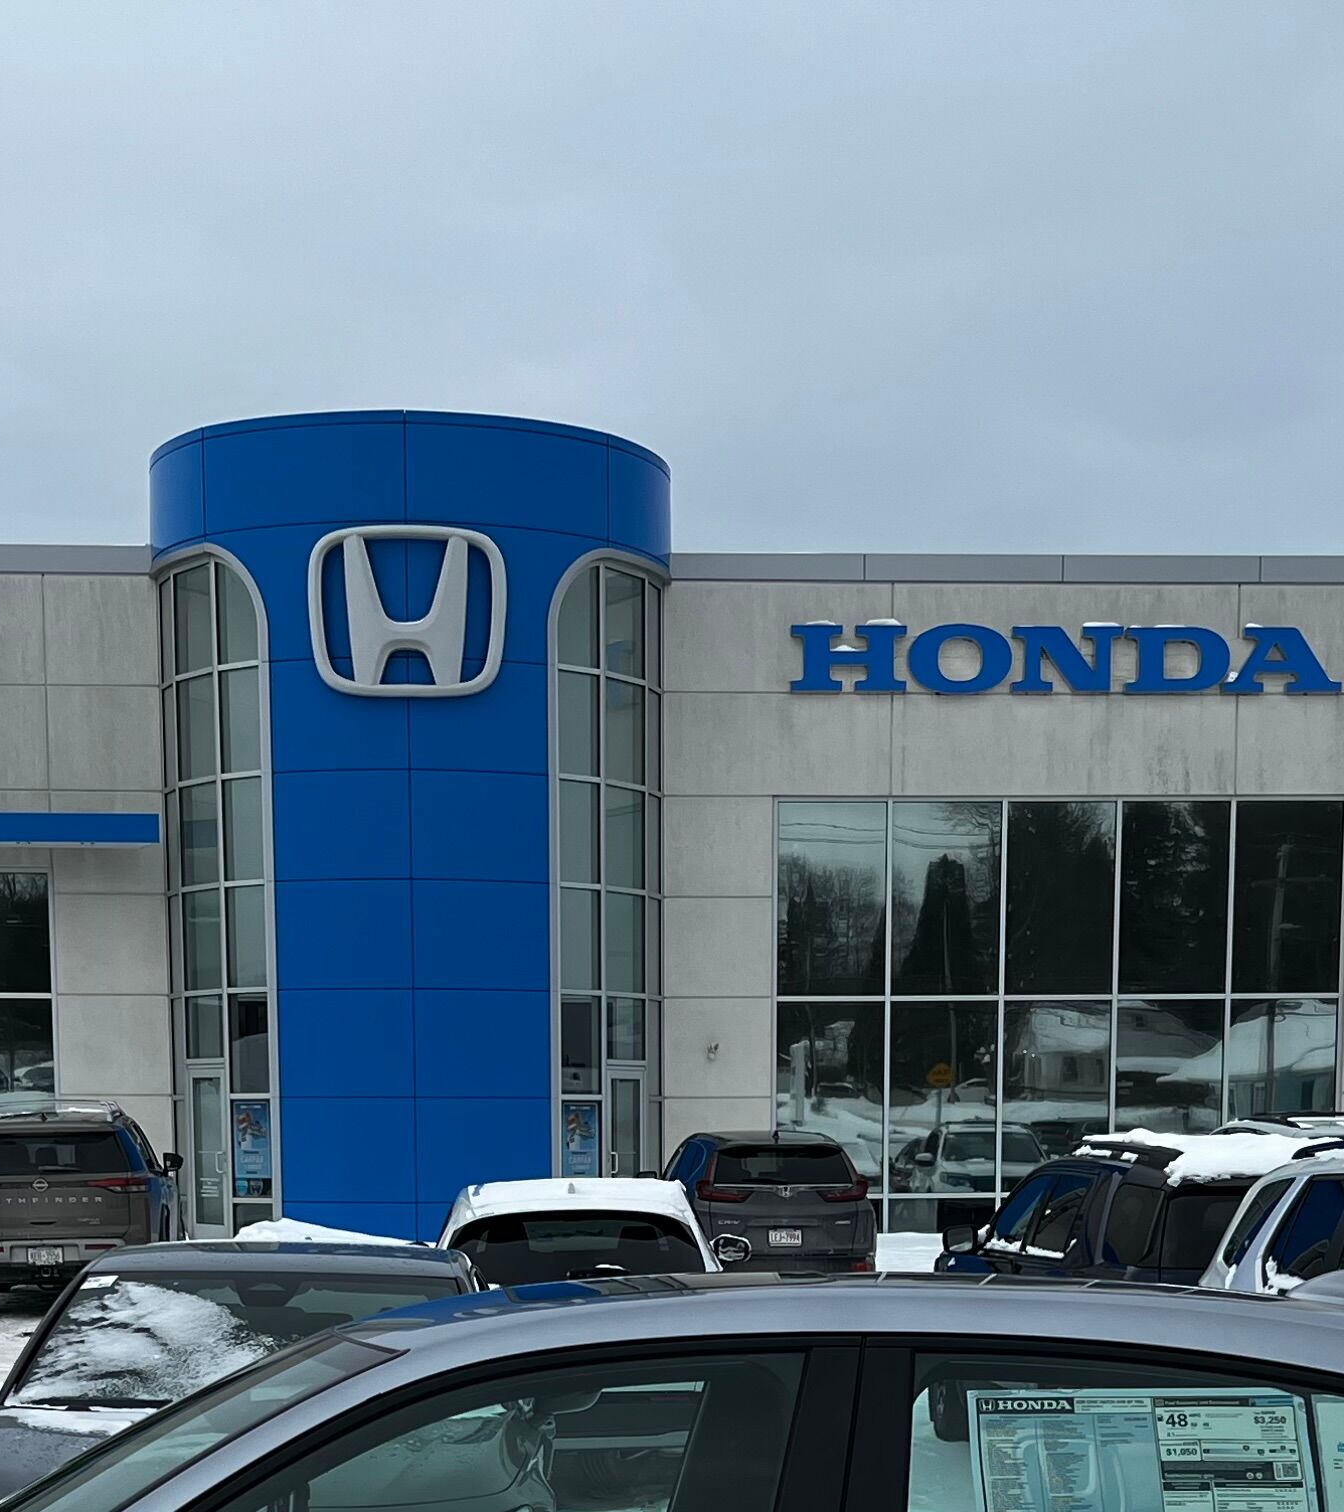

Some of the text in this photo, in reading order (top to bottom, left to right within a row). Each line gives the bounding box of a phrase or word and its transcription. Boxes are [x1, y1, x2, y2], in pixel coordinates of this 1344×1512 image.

[790, 623, 1343, 694] HONDA
[997, 1399, 1073, 1411] HONDA
[1165, 1413, 1189, 1428] 48
[1253, 1415, 1287, 1425] $3,250
[1165, 1448, 1198, 1457] $1,050
